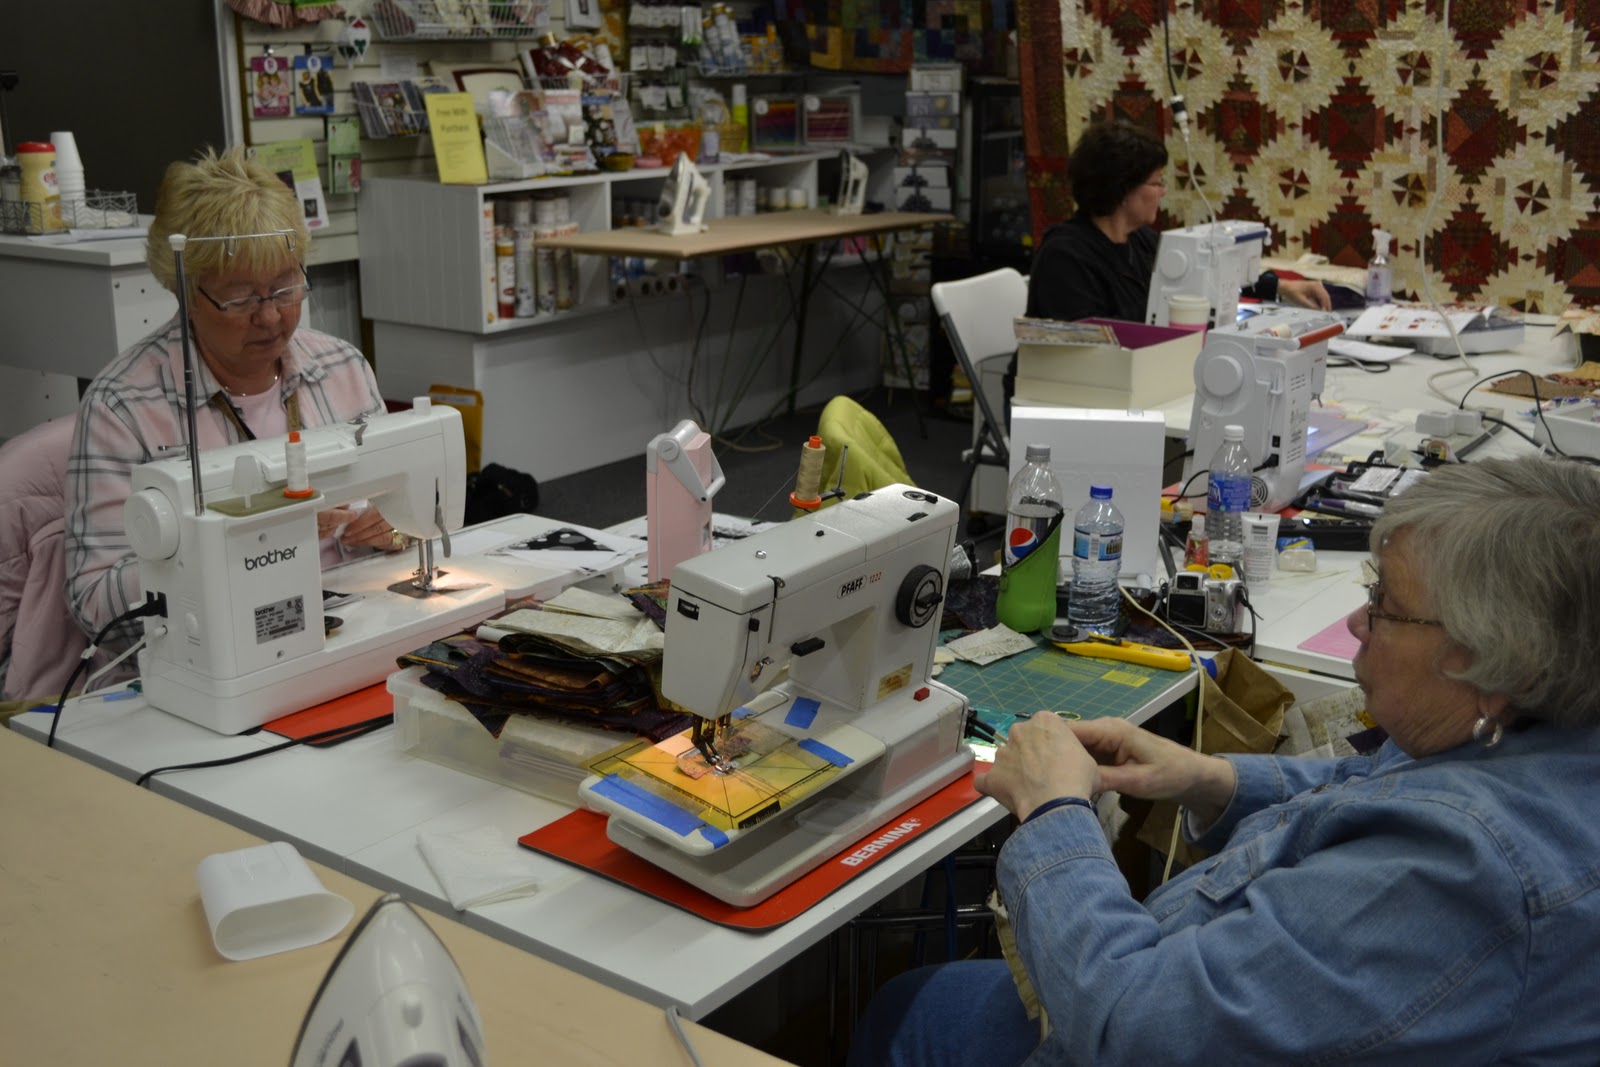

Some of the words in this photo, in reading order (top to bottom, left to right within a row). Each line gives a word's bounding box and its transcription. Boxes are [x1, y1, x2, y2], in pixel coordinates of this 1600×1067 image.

[244, 546, 298, 571] brother
[841, 577, 864, 597] PFAFF
[869, 571, 882, 584] 1222
[840, 822, 922, 867] BERNINA
